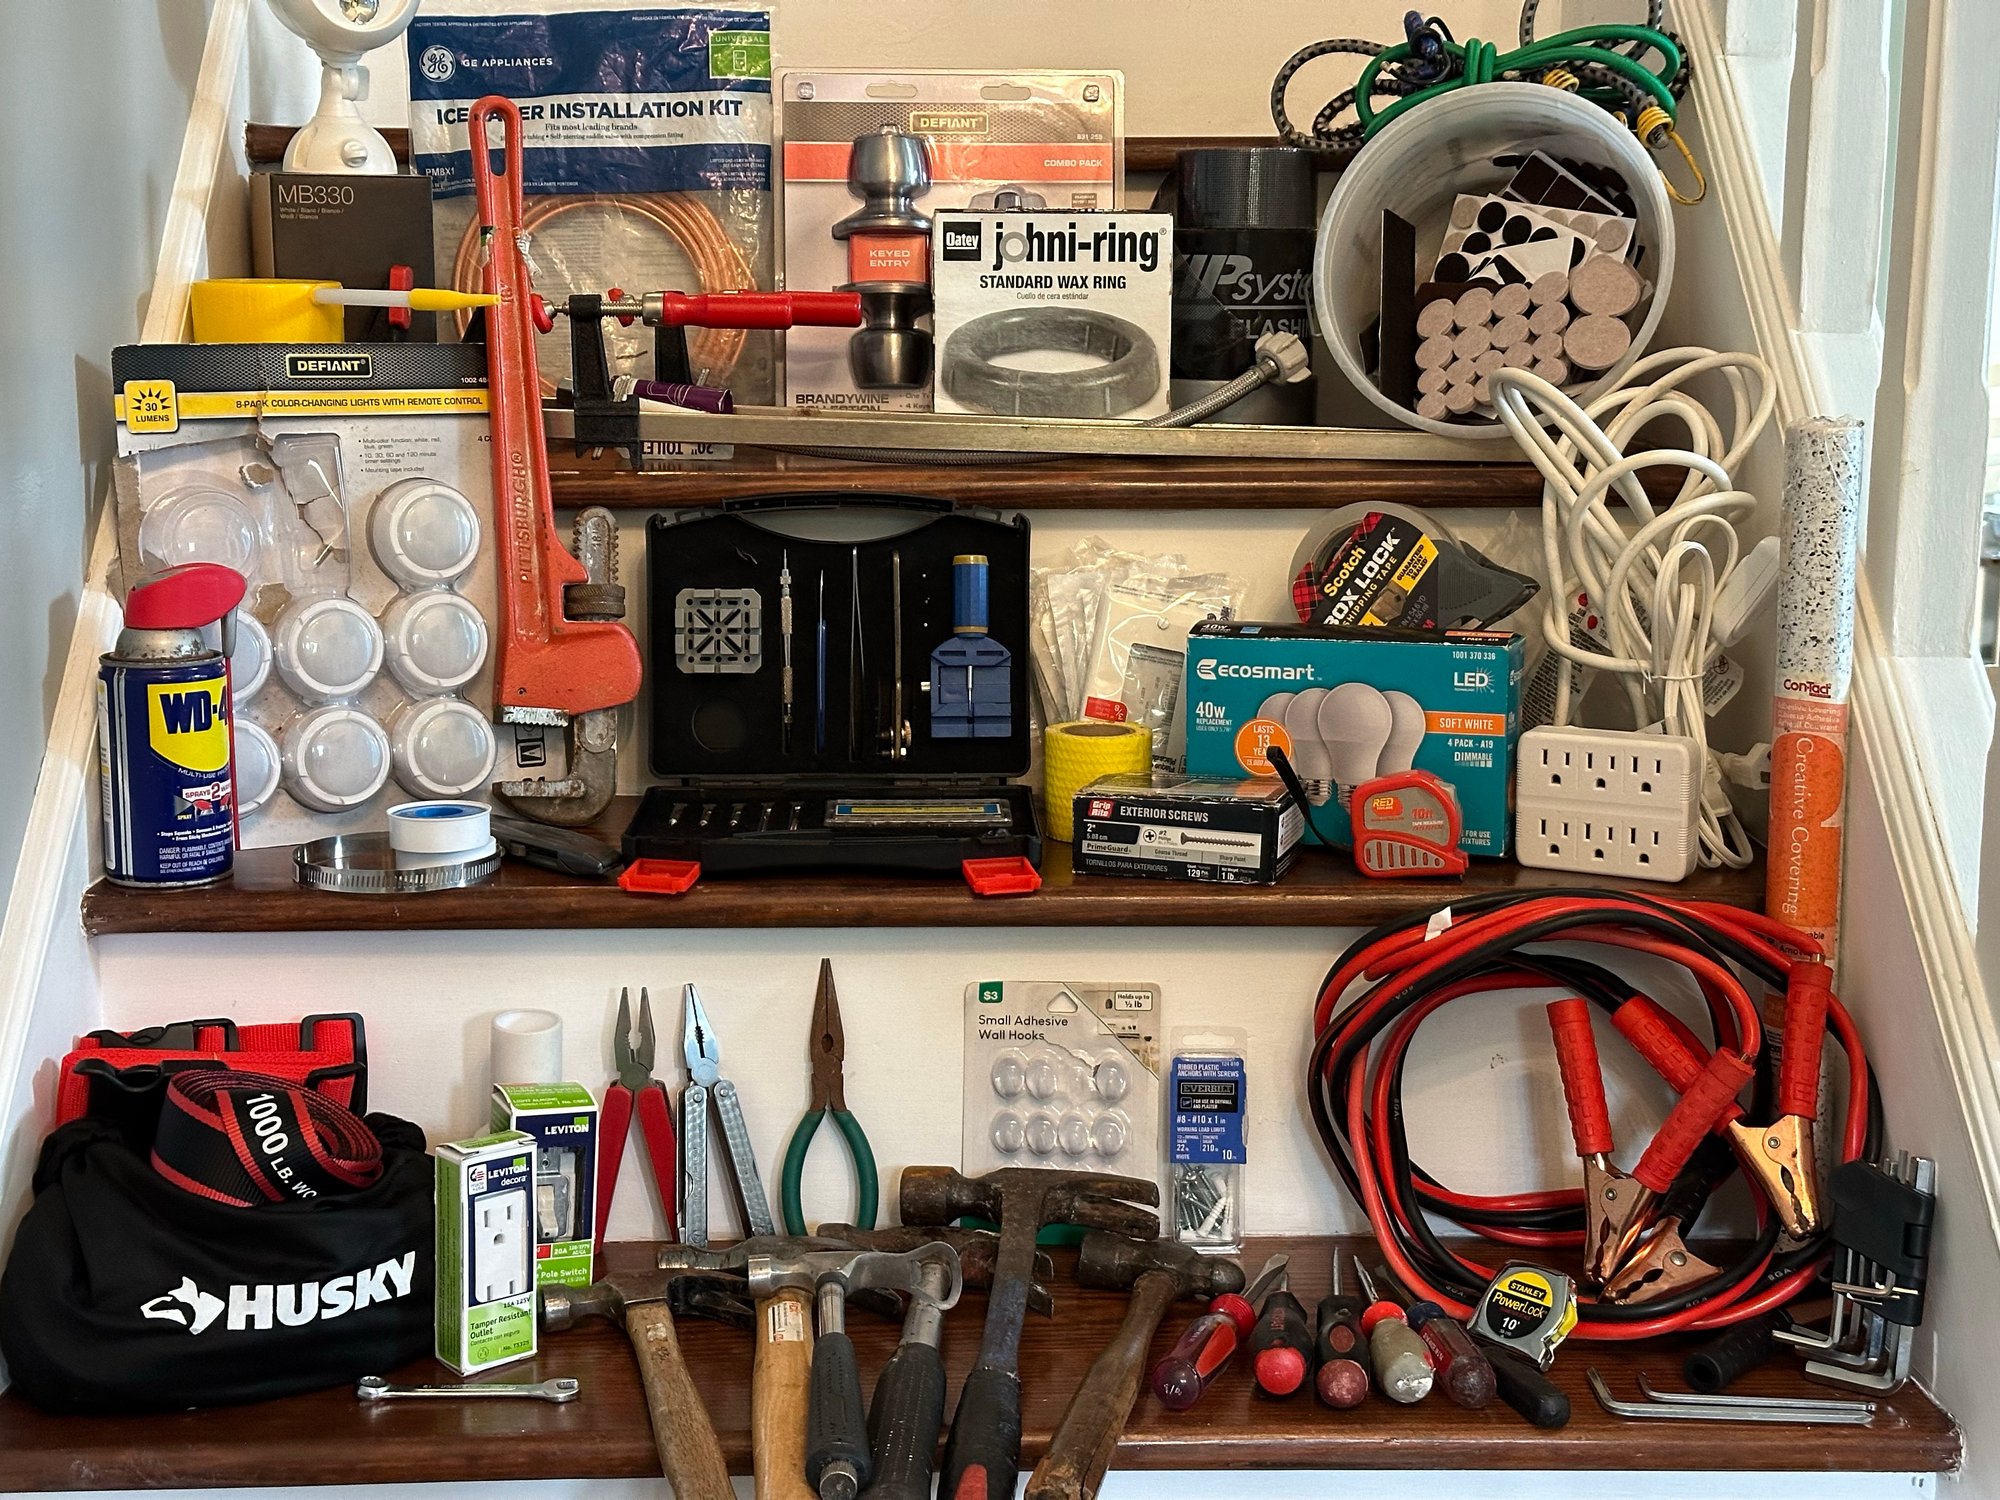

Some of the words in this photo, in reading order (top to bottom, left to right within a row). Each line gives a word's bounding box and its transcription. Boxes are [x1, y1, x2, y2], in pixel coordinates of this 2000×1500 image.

[462, 59, 478, 67] GE
[481, 57, 553, 67] APPLIANCES
[550, 100, 703, 119] INSTALLATION
[709, 99, 743, 116] KIT
[545, 123, 561, 131] Fits
[582, 123, 611, 131] leading
[611, 122, 638, 131] brands
[919, 117, 978, 129] DEFIANT
[1044, 159, 1076, 167] COMBO
[1078, 159, 1103, 167] PACK
[278, 184, 355, 205] MB330
[945, 231, 979, 249] Oatey
[992, 221, 1159, 273] johni-ring
[869, 249, 911, 258] KEYED
[869, 259, 911, 268] ENTRY
[979, 275, 1054, 289] STANDARD
[1057, 275, 1089, 289] WAX
[1092, 275, 1128, 289] RING
[1037, 291, 1046, 300] de
[297, 360, 361, 372] DEFIANT
[271, 398, 348, 408] COLOR-CHANGING
[350, 398, 381, 407] LIGHTS
[383, 397, 405, 406] WITH
[407, 397, 442, 406] REMOTE
[443, 396, 484, 406] CONTROL
[795, 393, 890, 405] BRANDYWINE
[144, 402, 159, 412] 30
[135, 414, 170, 424] LUMENS
[1354, 531, 1401, 591] LOCK
[1323, 547, 1367, 598] Scotch
[1343, 582, 1378, 627] SHIPPING
[1376, 556, 1398, 582] TAPE
[1452, 651, 1468, 660] 1001
[1469, 651, 1482, 660] 370
[1453, 671, 1490, 688] LED
[1195, 718, 1233, 726] REPLACEMENT
[1439, 717, 1464, 729] SOFT
[1464, 718, 1494, 730] WHITE
[1253, 724, 1275, 734] LASTS
[1256, 734, 1270, 748] 13
[1447, 738, 1453, 747] 4
[1454, 738, 1474, 748] PACK
[1480, 740, 1494, 749] A19
[1454, 751, 1493, 762] DIMMABLE
[1793, 736, 1815, 820] Creative
[184, 790, 211, 799] SPRAYS
[210, 782, 221, 800] 2
[1092, 800, 1111, 809] Grip
[1120, 805, 1167, 820] EXTERIOR
[1168, 811, 1209, 824] SCREWS
[1465, 831, 1478, 839] FOR
[1478, 831, 1492, 839] USE
[1461, 838, 1491, 847] FIXTURES
[1085, 858, 1117, 869] TORNILLOS
[1116, 861, 1133, 870] PARA
[1133, 862, 1168, 873] EXTERIORES
[1781, 826, 1810, 914] Covering
[1187, 869, 1201, 878] 129
[1134, 1000, 1143, 1008] lb
[978, 1014, 1012, 1027] Small
[1014, 1014, 1069, 1027] Adhesive
[978, 1029, 1007, 1041] Wall
[1008, 1029, 1046, 1042] Hooks
[1198, 1063, 1220, 1072] PLASTIC
[1216, 1070, 1240, 1078] SCREWS
[1182, 1083, 1234, 1093] EVERBILT
[1176, 1115, 1186, 1124] #8
[1191, 1115, 1206, 1124] #10
[544, 1123, 590, 1136] LEVITON
[246, 1092, 290, 1155] 1000
[270, 1156, 299, 1188] LB.
[1176, 1143, 1185, 1152] 22
[1202, 1143, 1215, 1152] 210
[1222, 1149, 1233, 1160] 10
[487, 1165, 528, 1180] LEVITON
[500, 1176, 528, 1187] decora
[541, 1270, 559, 1279] Pole
[560, 1267, 588, 1277] Switch
[226, 1250, 416, 1331] HUSKY
[1509, 1281, 1545, 1299] STANLEY
[1492, 1291, 1545, 1319] PowerLock
[469, 1317, 499, 1332] Tamper
[498, 1308, 533, 1324] Resistant
[469, 1327, 494, 1340] Outlet
